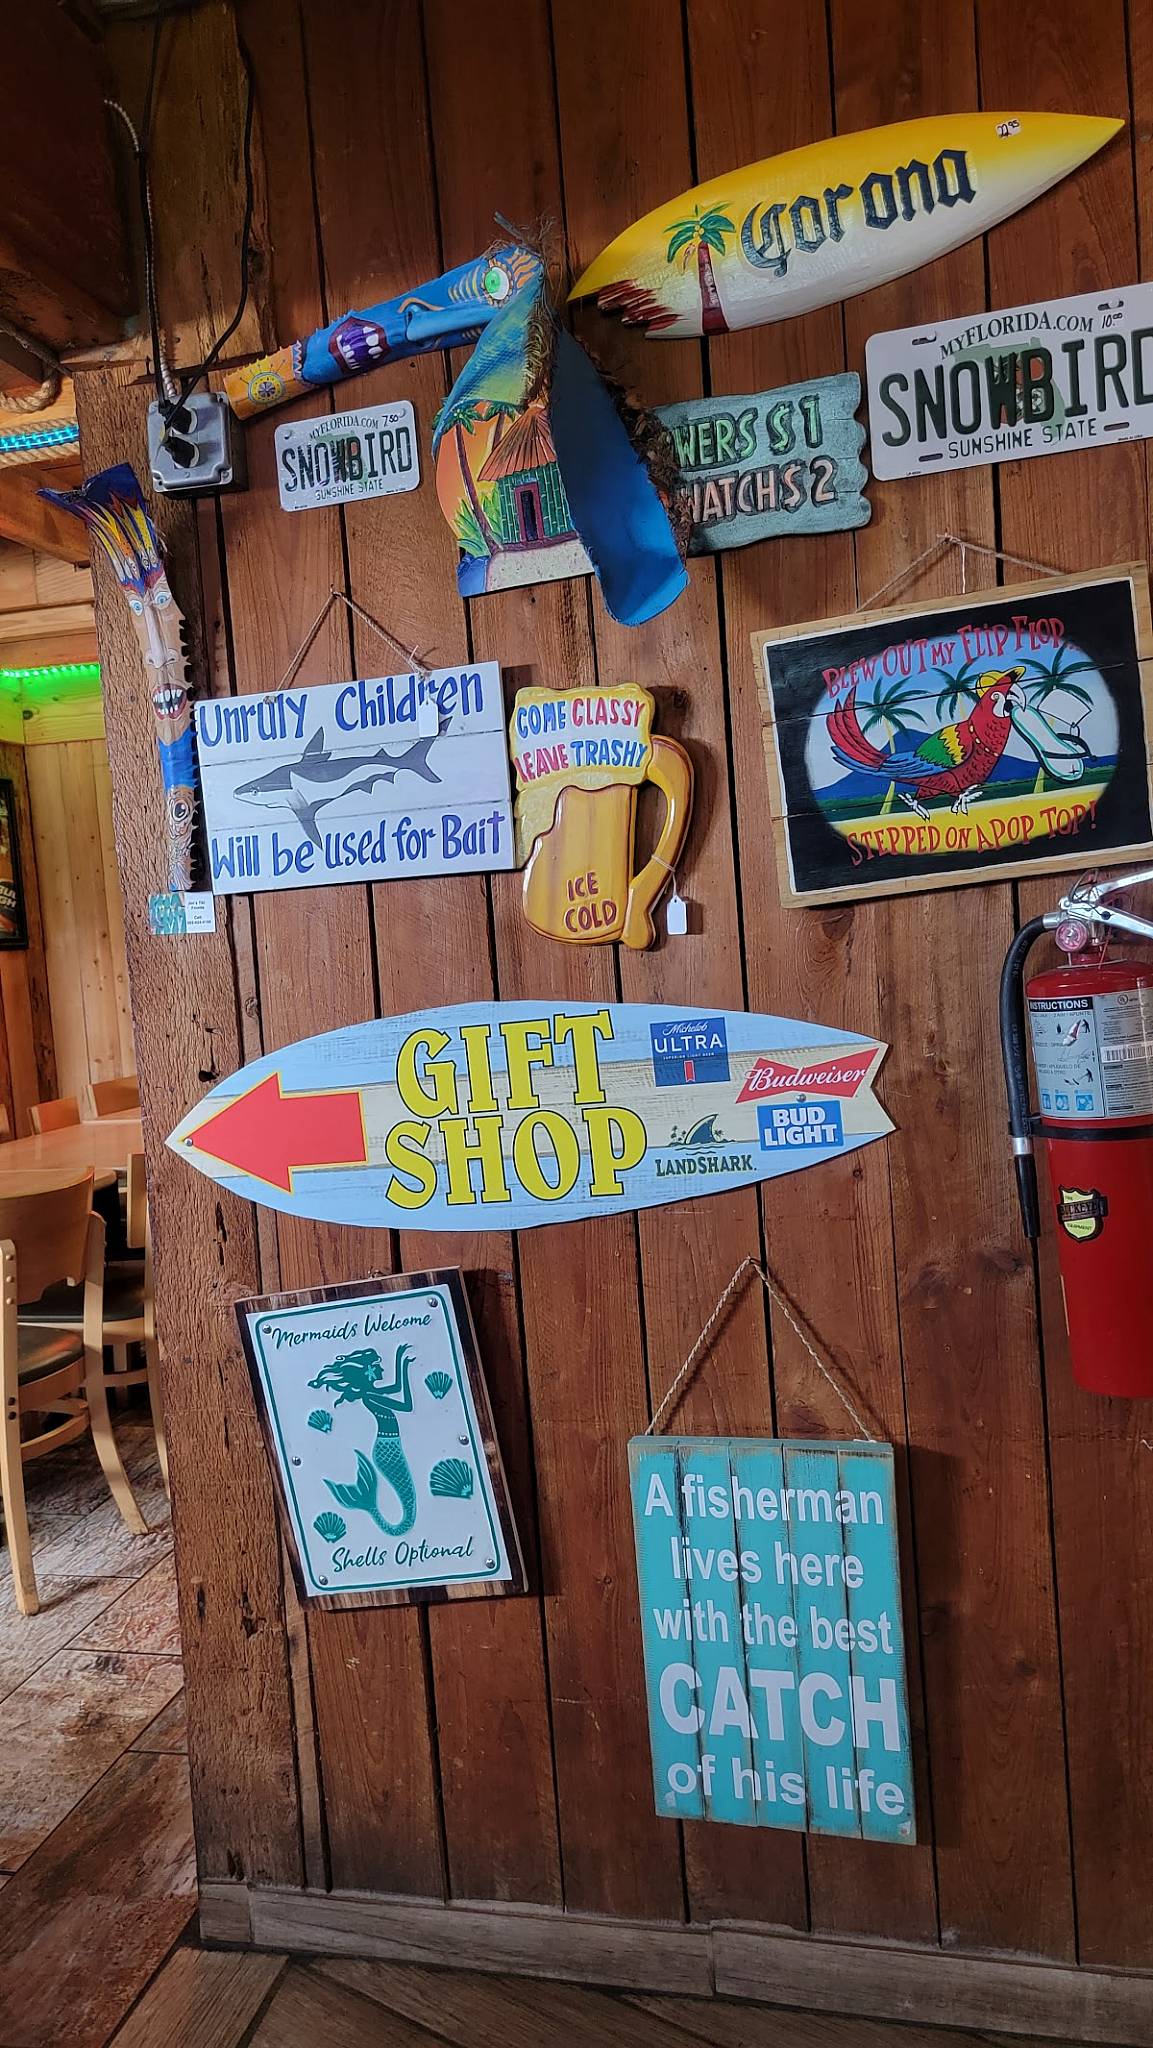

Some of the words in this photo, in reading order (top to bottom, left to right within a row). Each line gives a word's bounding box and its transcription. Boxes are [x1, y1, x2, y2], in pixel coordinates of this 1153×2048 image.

[740, 149, 977, 278] Corona
[939, 311, 1094, 360] MYFLORIDA.COM
[309, 415, 379, 440] MYFLORIDA.COM
[948, 428, 1033, 459] SUNSHINE
[1043, 418, 1098, 443] STATE
[281, 426, 413, 492] SNOWBIRD
[315, 484, 354, 500] SUNSHINE
[358, 479, 384, 493] STATE
[821, 656, 878, 698] BLEW
[882, 638, 929, 677] OUT
[931, 641, 956, 667] MY
[199, 694, 308, 748] Unruly
[335, 673, 484, 731] Children
[516, 701, 566, 739] COME
[572, 697, 645, 727] CLASSY
[513, 744, 569, 783] LEAVE
[570, 739, 649, 768] TRASHY
[212, 832, 261, 880] Will
[272, 832, 314, 876] be
[325, 820, 386, 869] used
[392, 816, 436, 861] for
[442, 811, 505, 859] Bait
[847, 825, 941, 866] STEPPED
[945, 826, 973, 849] ON
[975, 824, 993, 853] A
[989, 815, 1035, 850] POP
[1040, 800, 1097, 838] TOP!
[567, 872, 599, 901] ICE
[563, 900, 618, 933] COLD
[1030, 999, 1089, 1010] INSTRUCTIONS
[654, 1033, 723, 1053] ULTRA
[662, 1021, 709, 1036] Michelob
[396, 1009, 615, 1118] GIFT
[744, 1065, 867, 1092] Budweiser
[763, 1125, 838, 1147] LIGHT
[772, 1107, 825, 1127] BUD
[385, 1106, 648, 1210] SHOP
[271, 1321, 358, 1349] Mermaids
[363, 1313, 432, 1338] Welcome
[645, 1473, 674, 1516] A
[681, 1474, 884, 1525] fisherman
[331, 1547, 387, 1573] Shells
[394, 1536, 473, 1567] Optional
[670, 1536, 762, 1583] lives
[775, 1541, 864, 1588] here
[653, 1599, 729, 1643] with
[740, 1603, 798, 1648] the
[810, 1606, 894, 1654] best
[659, 1662, 901, 1752] CATCH
[667, 1754, 715, 1796] of
[732, 1757, 807, 1806] his
[826, 1765, 906, 1815] life
